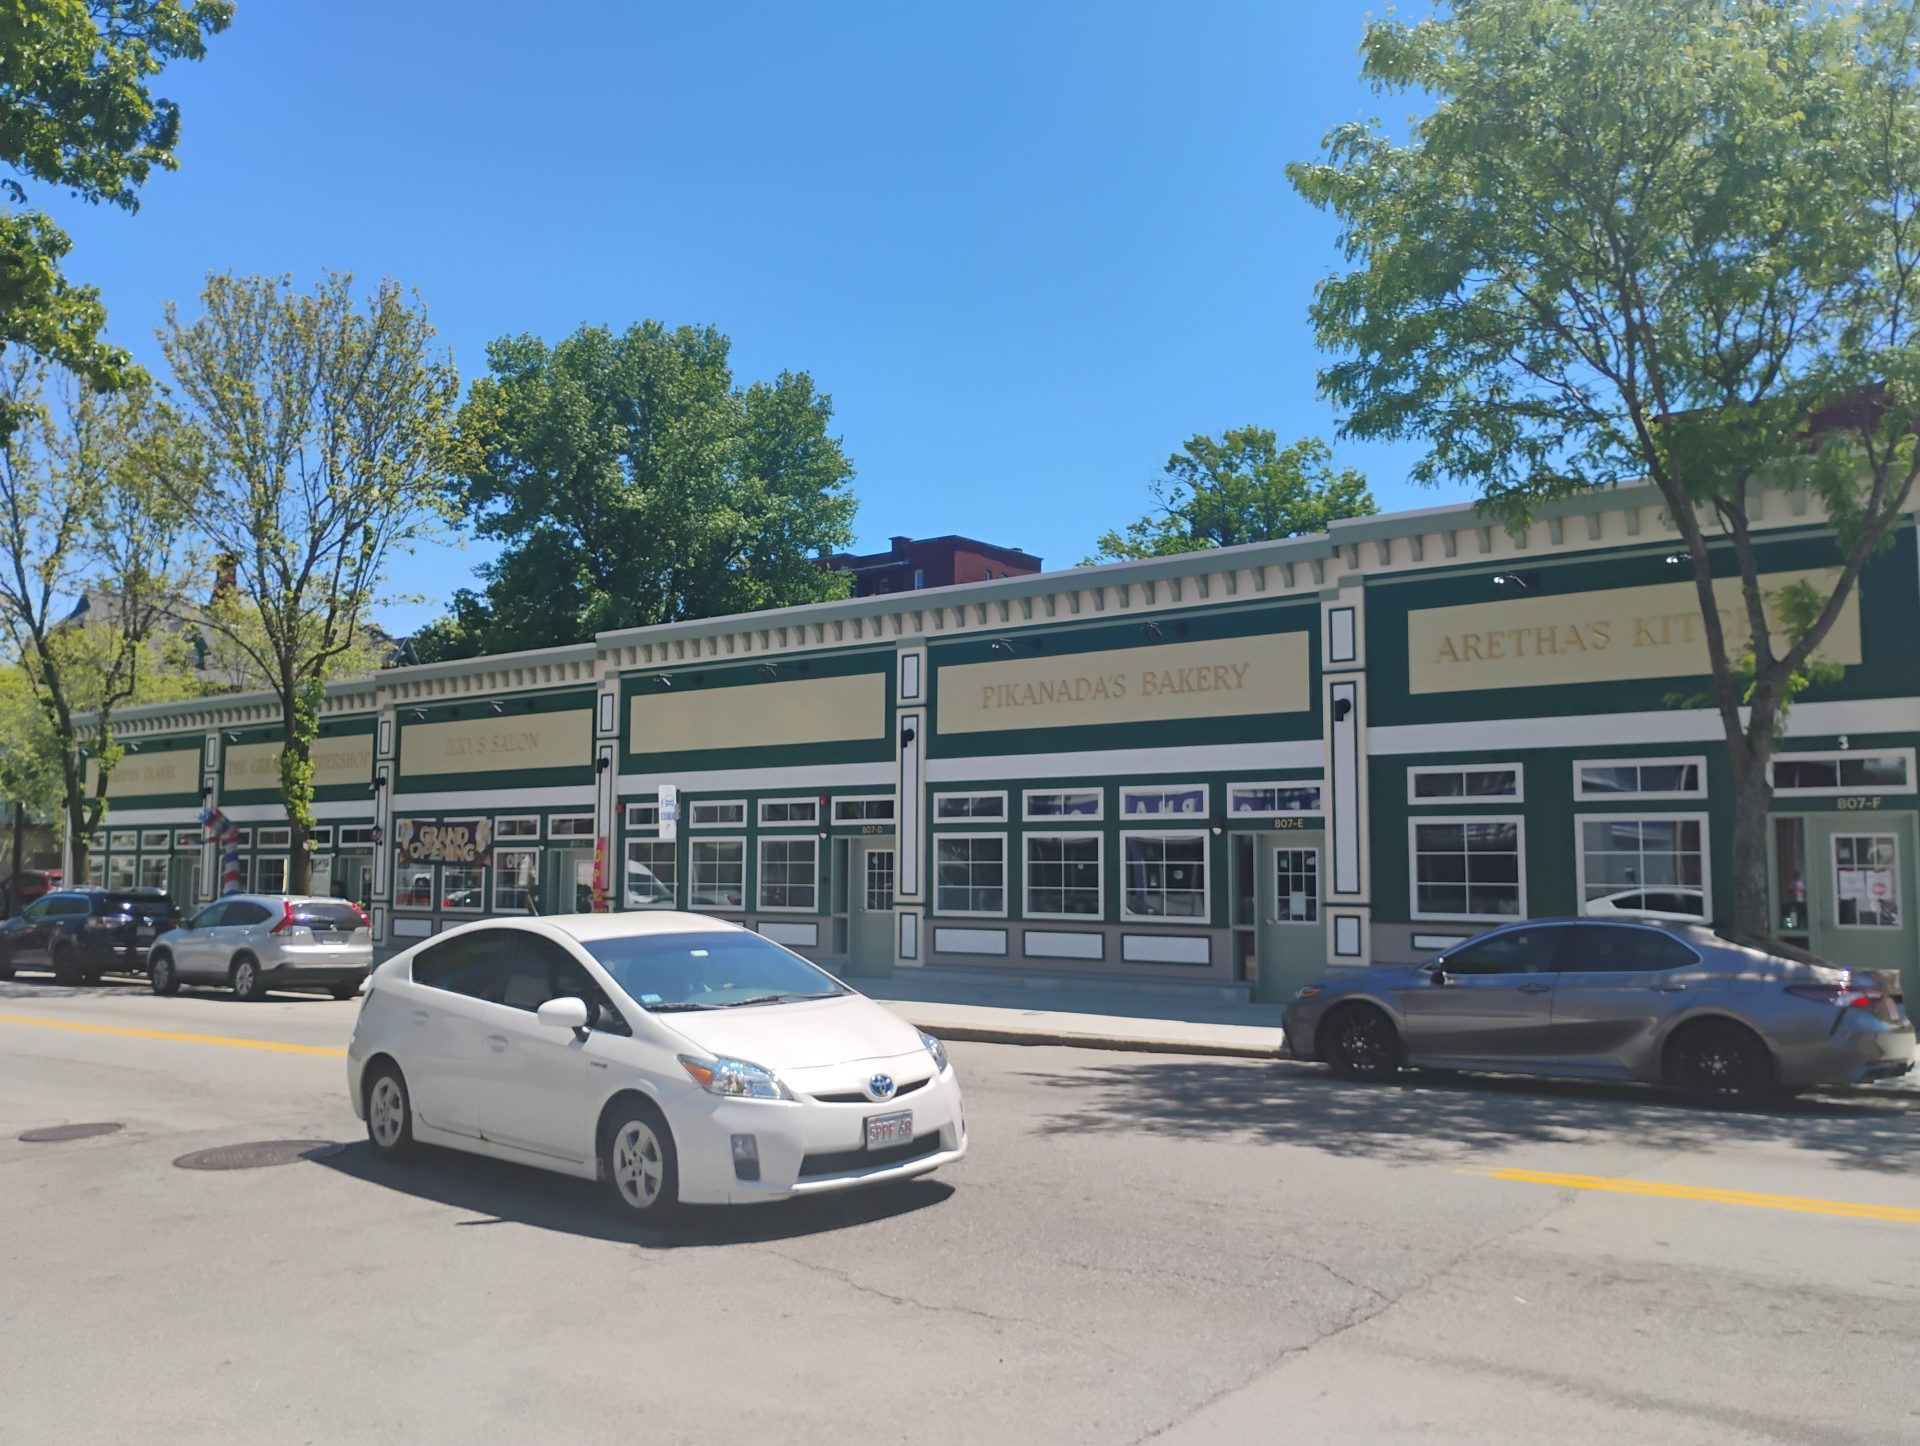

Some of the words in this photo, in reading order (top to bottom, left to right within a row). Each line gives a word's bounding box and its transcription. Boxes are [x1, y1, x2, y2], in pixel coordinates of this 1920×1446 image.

[1433, 620, 1612, 665] ARETHA'S
[981, 673, 1128, 710] PIKANADA'S
[1140, 662, 1251, 698] BAKERY
[491, 730, 541, 754] SALON
[304, 749, 372, 775] BERSHOP
[1837, 796, 1882, 810] 807-F
[420, 825, 469, 844] GRAND
[1274, 818, 1304, 829] 807-E
[409, 841, 477, 863] OPENING
